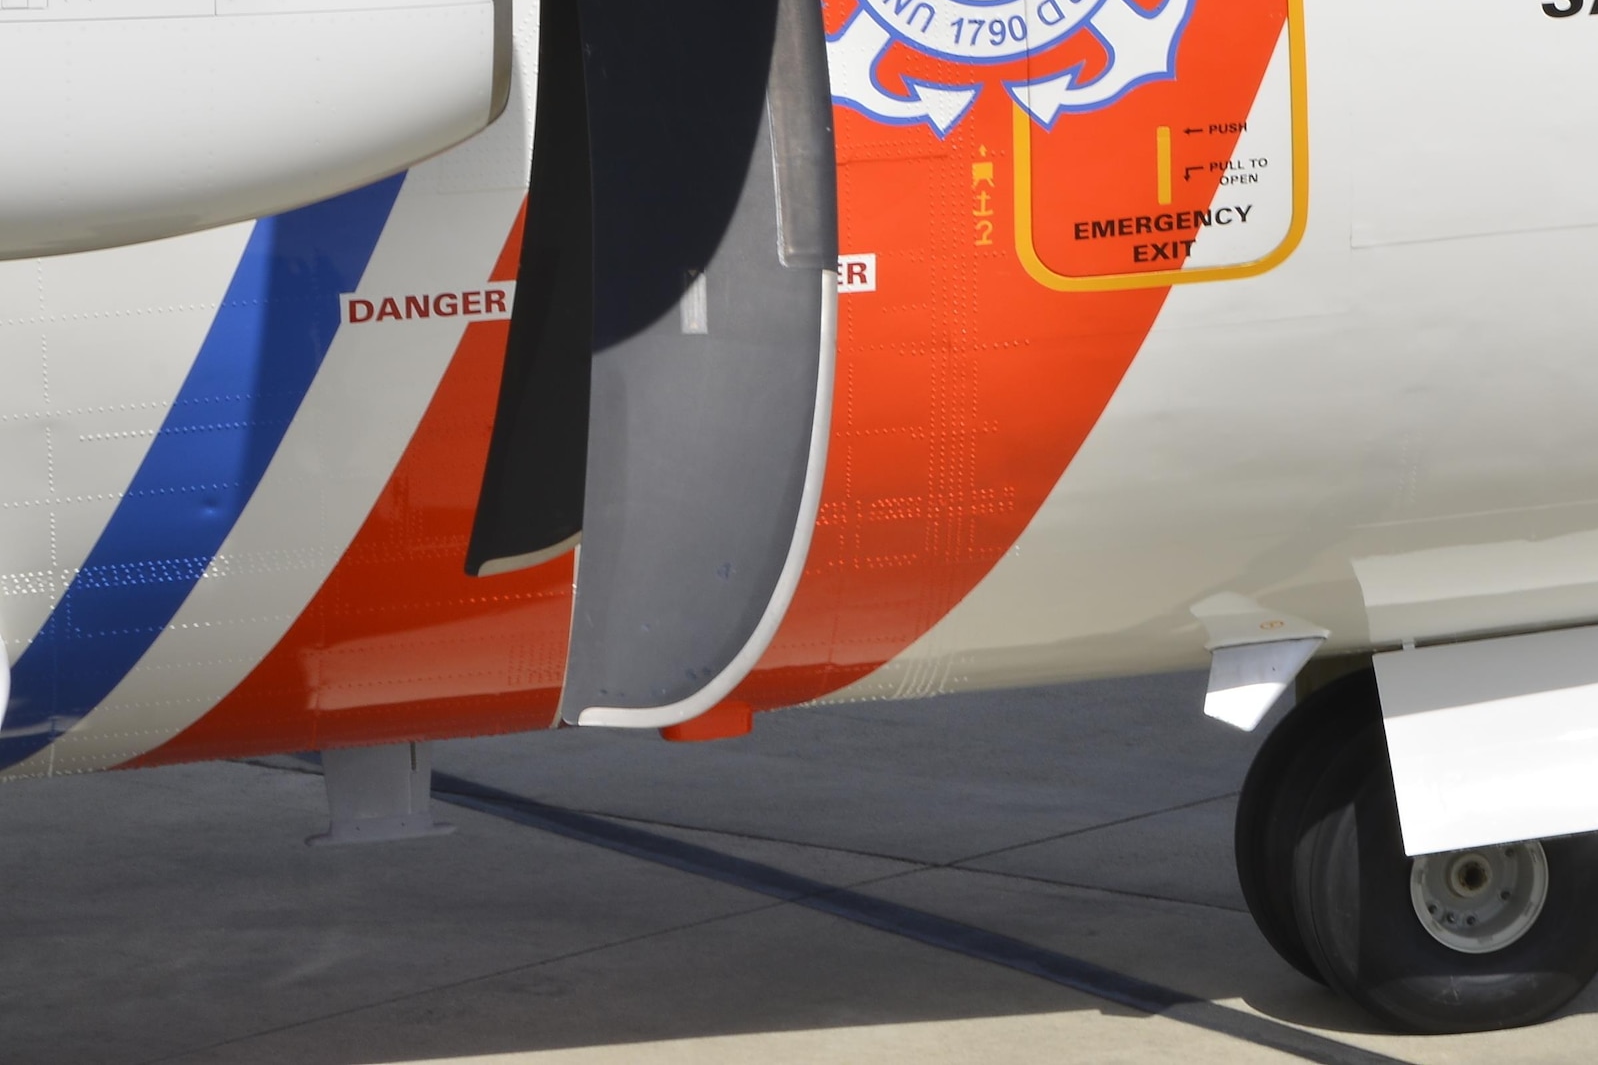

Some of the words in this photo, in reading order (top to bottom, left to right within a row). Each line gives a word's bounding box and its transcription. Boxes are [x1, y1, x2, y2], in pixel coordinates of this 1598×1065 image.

[950, 15, 1028, 46] 1790
[1209, 122, 1248, 135] PUSH
[1209, 160, 1245, 173] PULL
[1249, 157, 1268, 169] TO
[1219, 173, 1259, 186] OPEN
[1074, 205, 1252, 241] EMERGENCY
[1133, 239, 1196, 263] EXIT
[348, 290, 507, 324] DANGER
